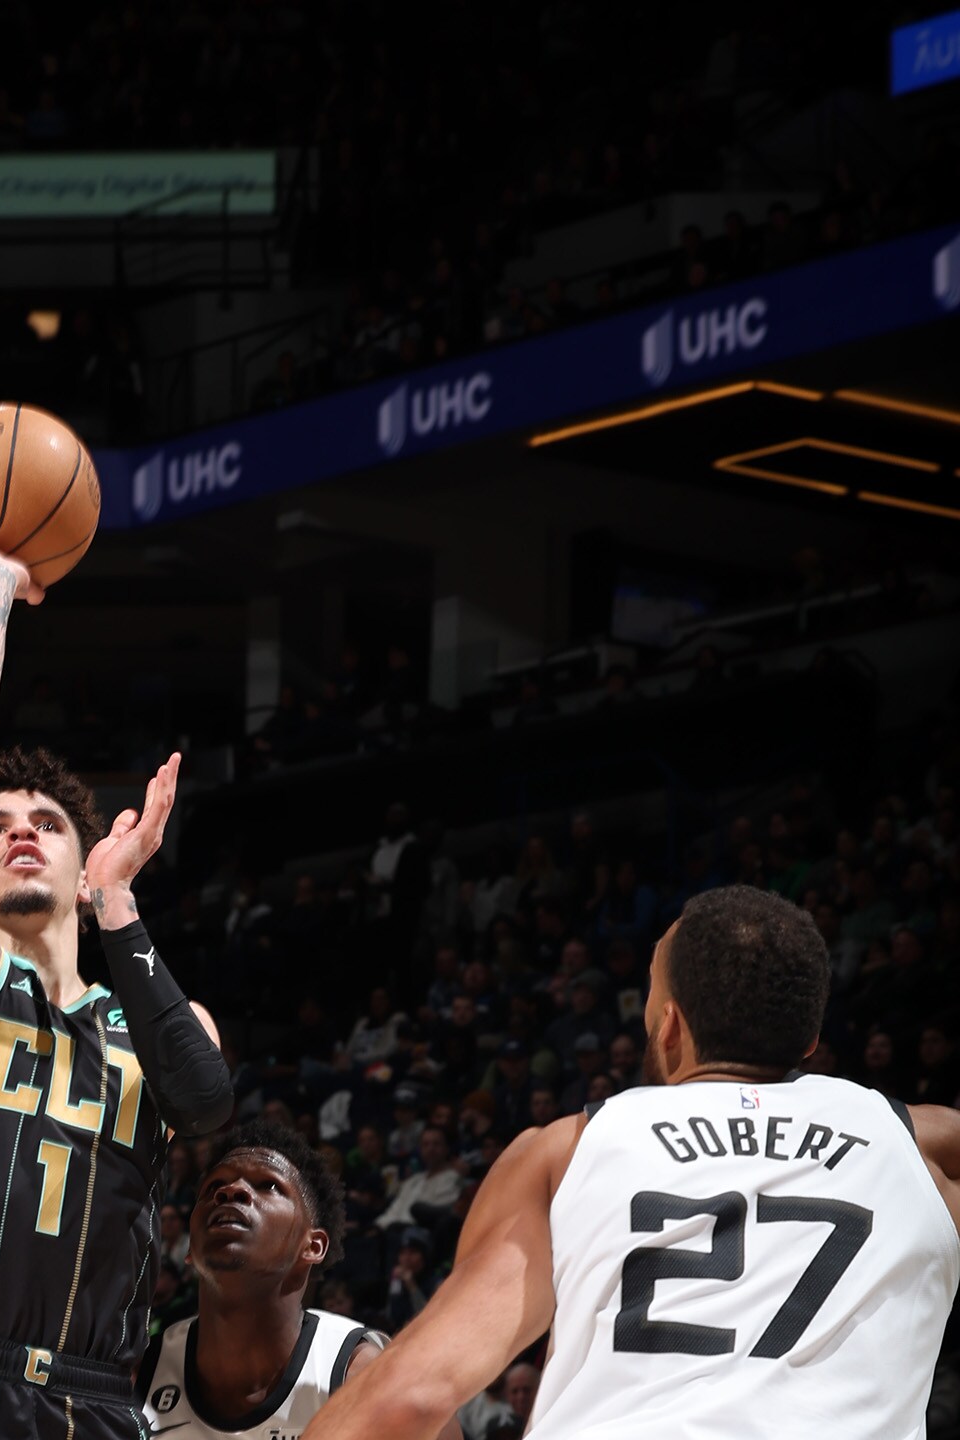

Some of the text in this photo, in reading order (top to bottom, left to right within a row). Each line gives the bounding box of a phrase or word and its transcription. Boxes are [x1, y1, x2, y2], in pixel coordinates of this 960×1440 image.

[678, 297, 768, 365] UHC
[411, 371, 492, 436] UHC
[168, 441, 241, 503] UHC
[651, 1116, 870, 1171] GOBERT
[35, 1138, 72, 1237] 1
[613, 1190, 874, 1359] 27
